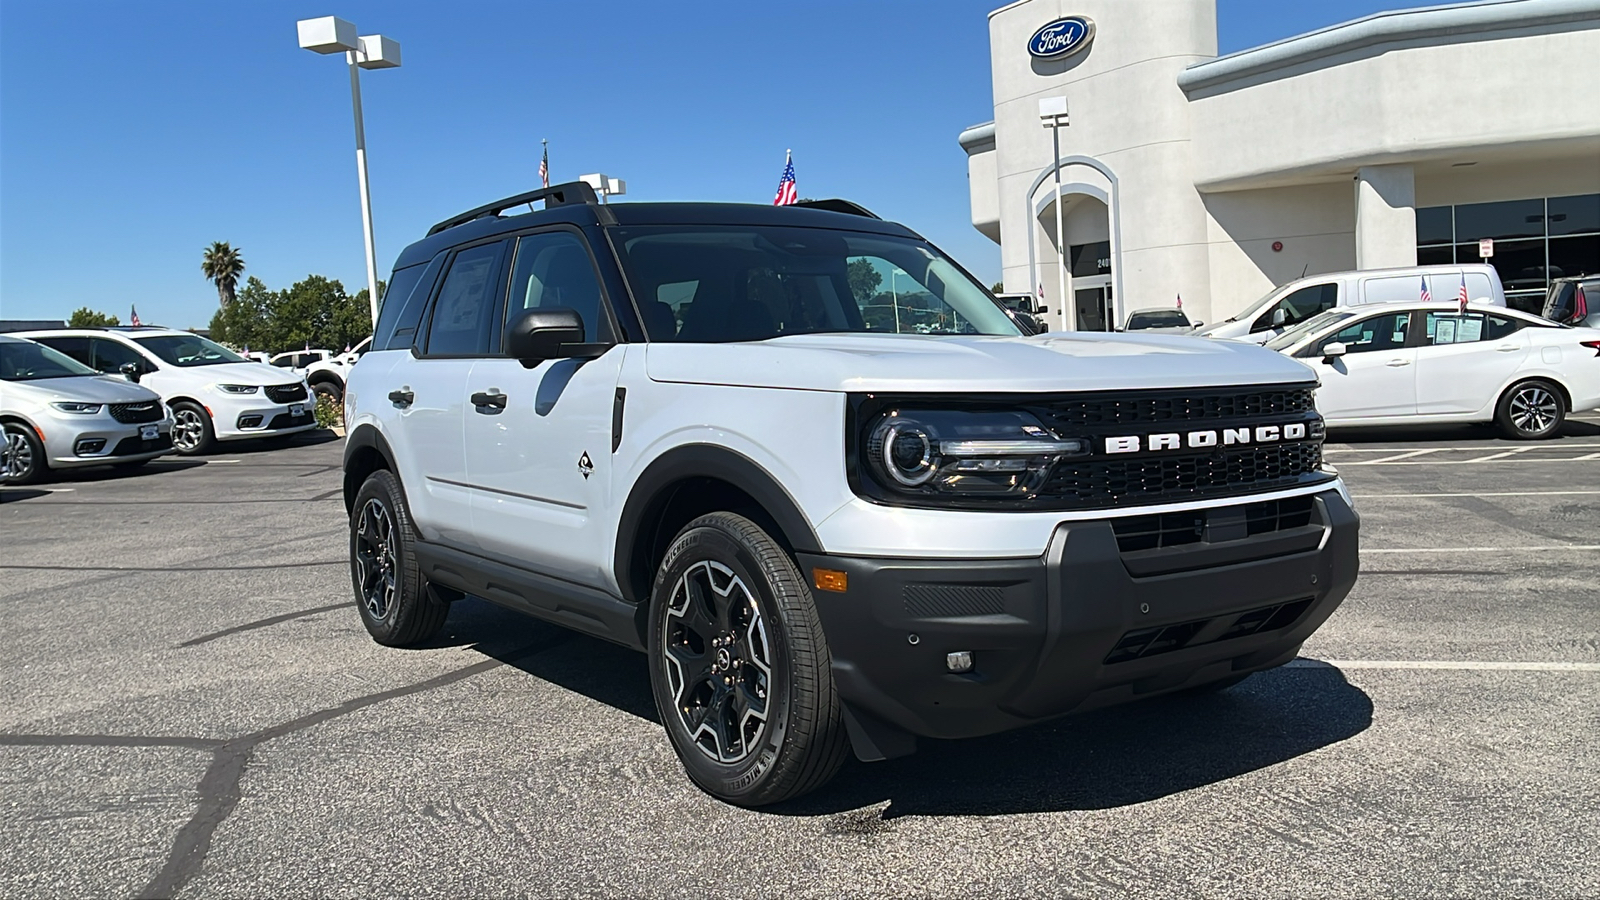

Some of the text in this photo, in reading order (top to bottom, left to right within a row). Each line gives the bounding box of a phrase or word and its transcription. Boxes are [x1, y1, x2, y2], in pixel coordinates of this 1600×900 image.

[1038, 24, 1074, 53] Ford
[1105, 423, 1306, 454] BRONCO
[665, 535, 699, 568] MICHELIN
